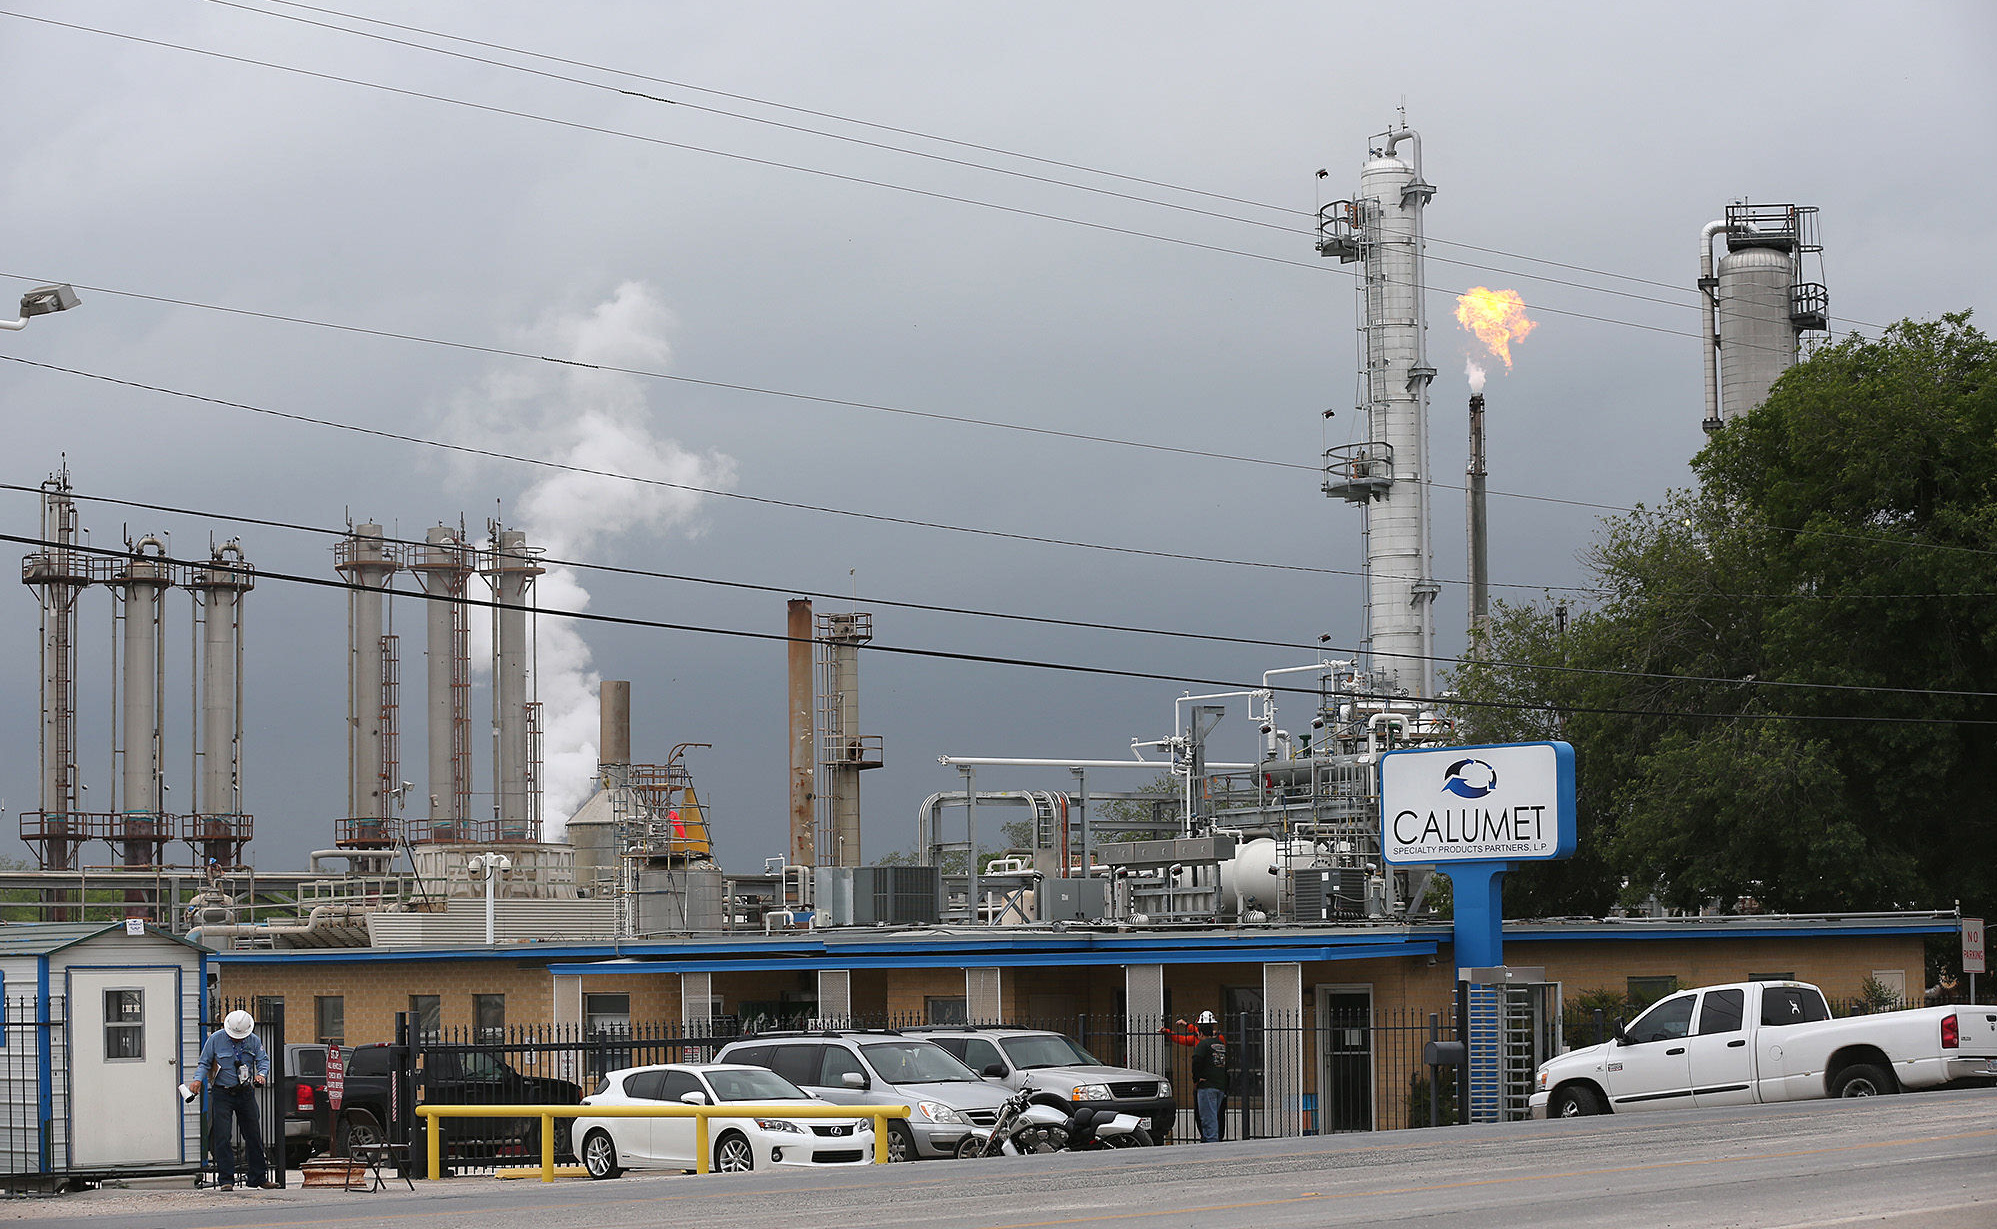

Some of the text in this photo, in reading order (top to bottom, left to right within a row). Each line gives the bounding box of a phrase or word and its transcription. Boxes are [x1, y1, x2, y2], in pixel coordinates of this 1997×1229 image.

[1393, 805, 1546, 845] CALUMET
[1393, 846, 1437, 856] SPECIALTY
[1438, 845, 1483, 854] PRODUCTS
[1484, 843, 1532, 852] PARTNERS,
[1967, 930, 1979, 943] NO
[1963, 949, 1984, 961] PARKING
